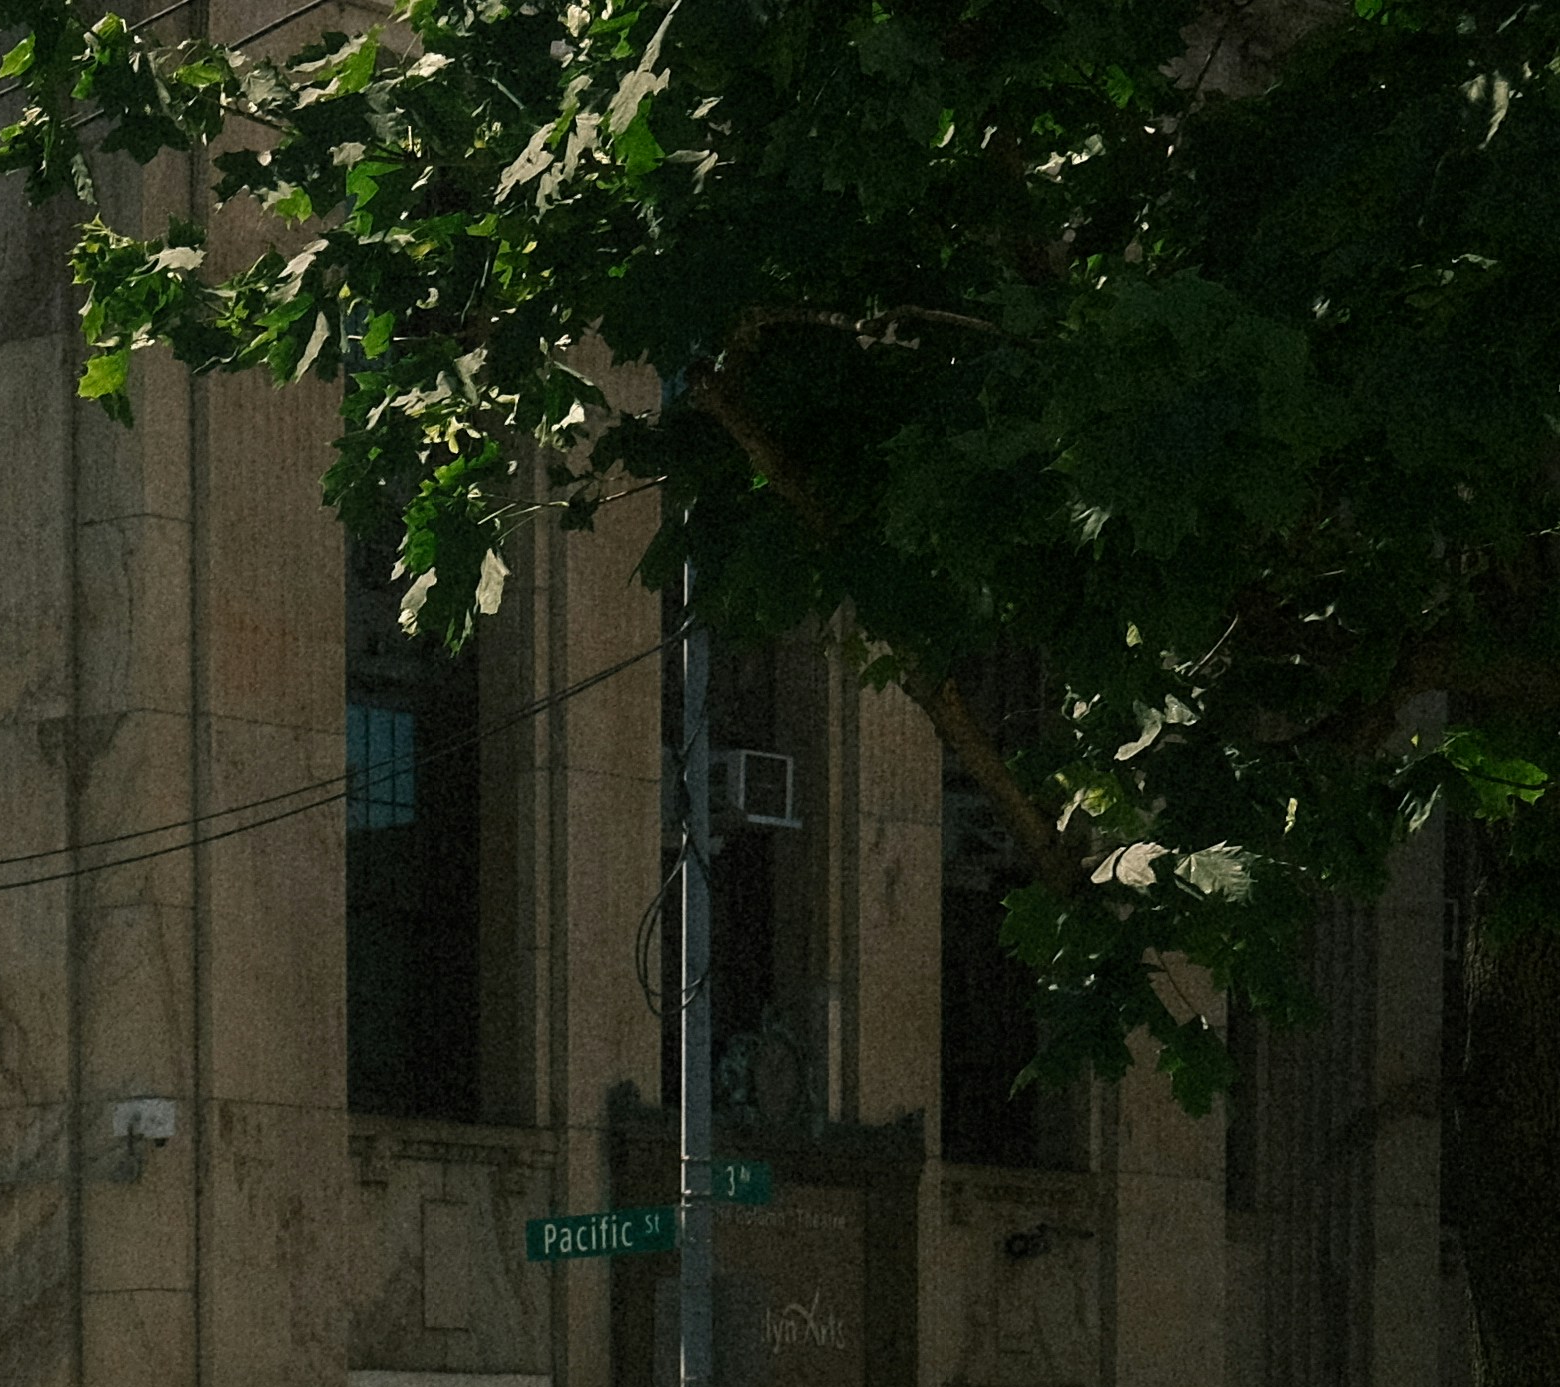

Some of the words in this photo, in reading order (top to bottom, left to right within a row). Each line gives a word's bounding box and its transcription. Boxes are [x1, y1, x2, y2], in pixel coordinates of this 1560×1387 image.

[724, 1165, 736, 1197] 3
[543, 1215, 634, 1254] Pacific
[644, 1213, 661, 1234] St
